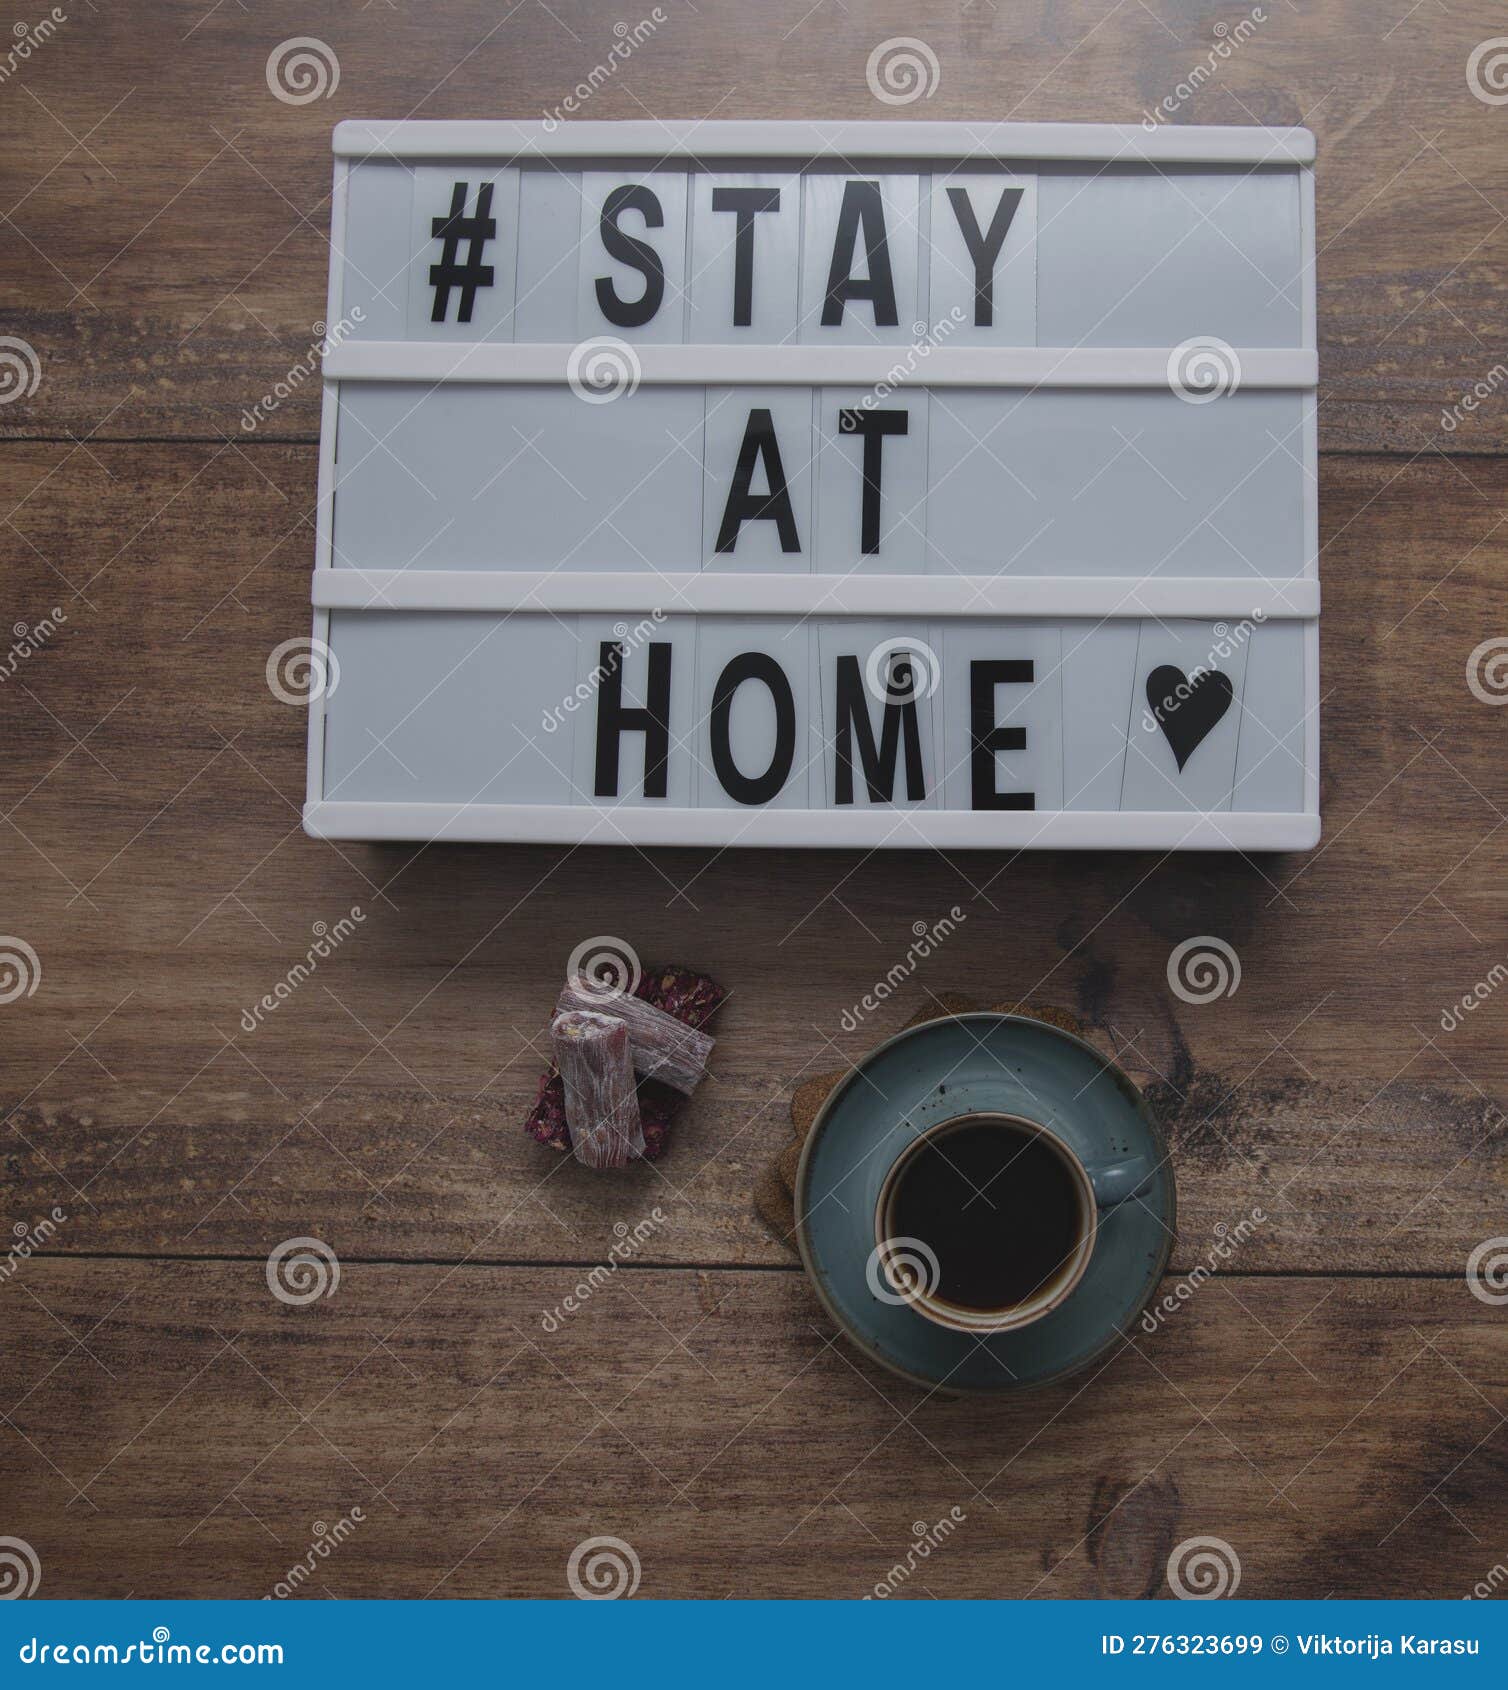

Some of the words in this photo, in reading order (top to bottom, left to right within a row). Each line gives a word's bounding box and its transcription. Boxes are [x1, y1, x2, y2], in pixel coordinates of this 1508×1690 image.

[428, 182, 497, 323] #
[594, 180, 1025, 328] STAY
[714, 408, 909, 555] AT
[594, 641, 1036, 811] HOME
